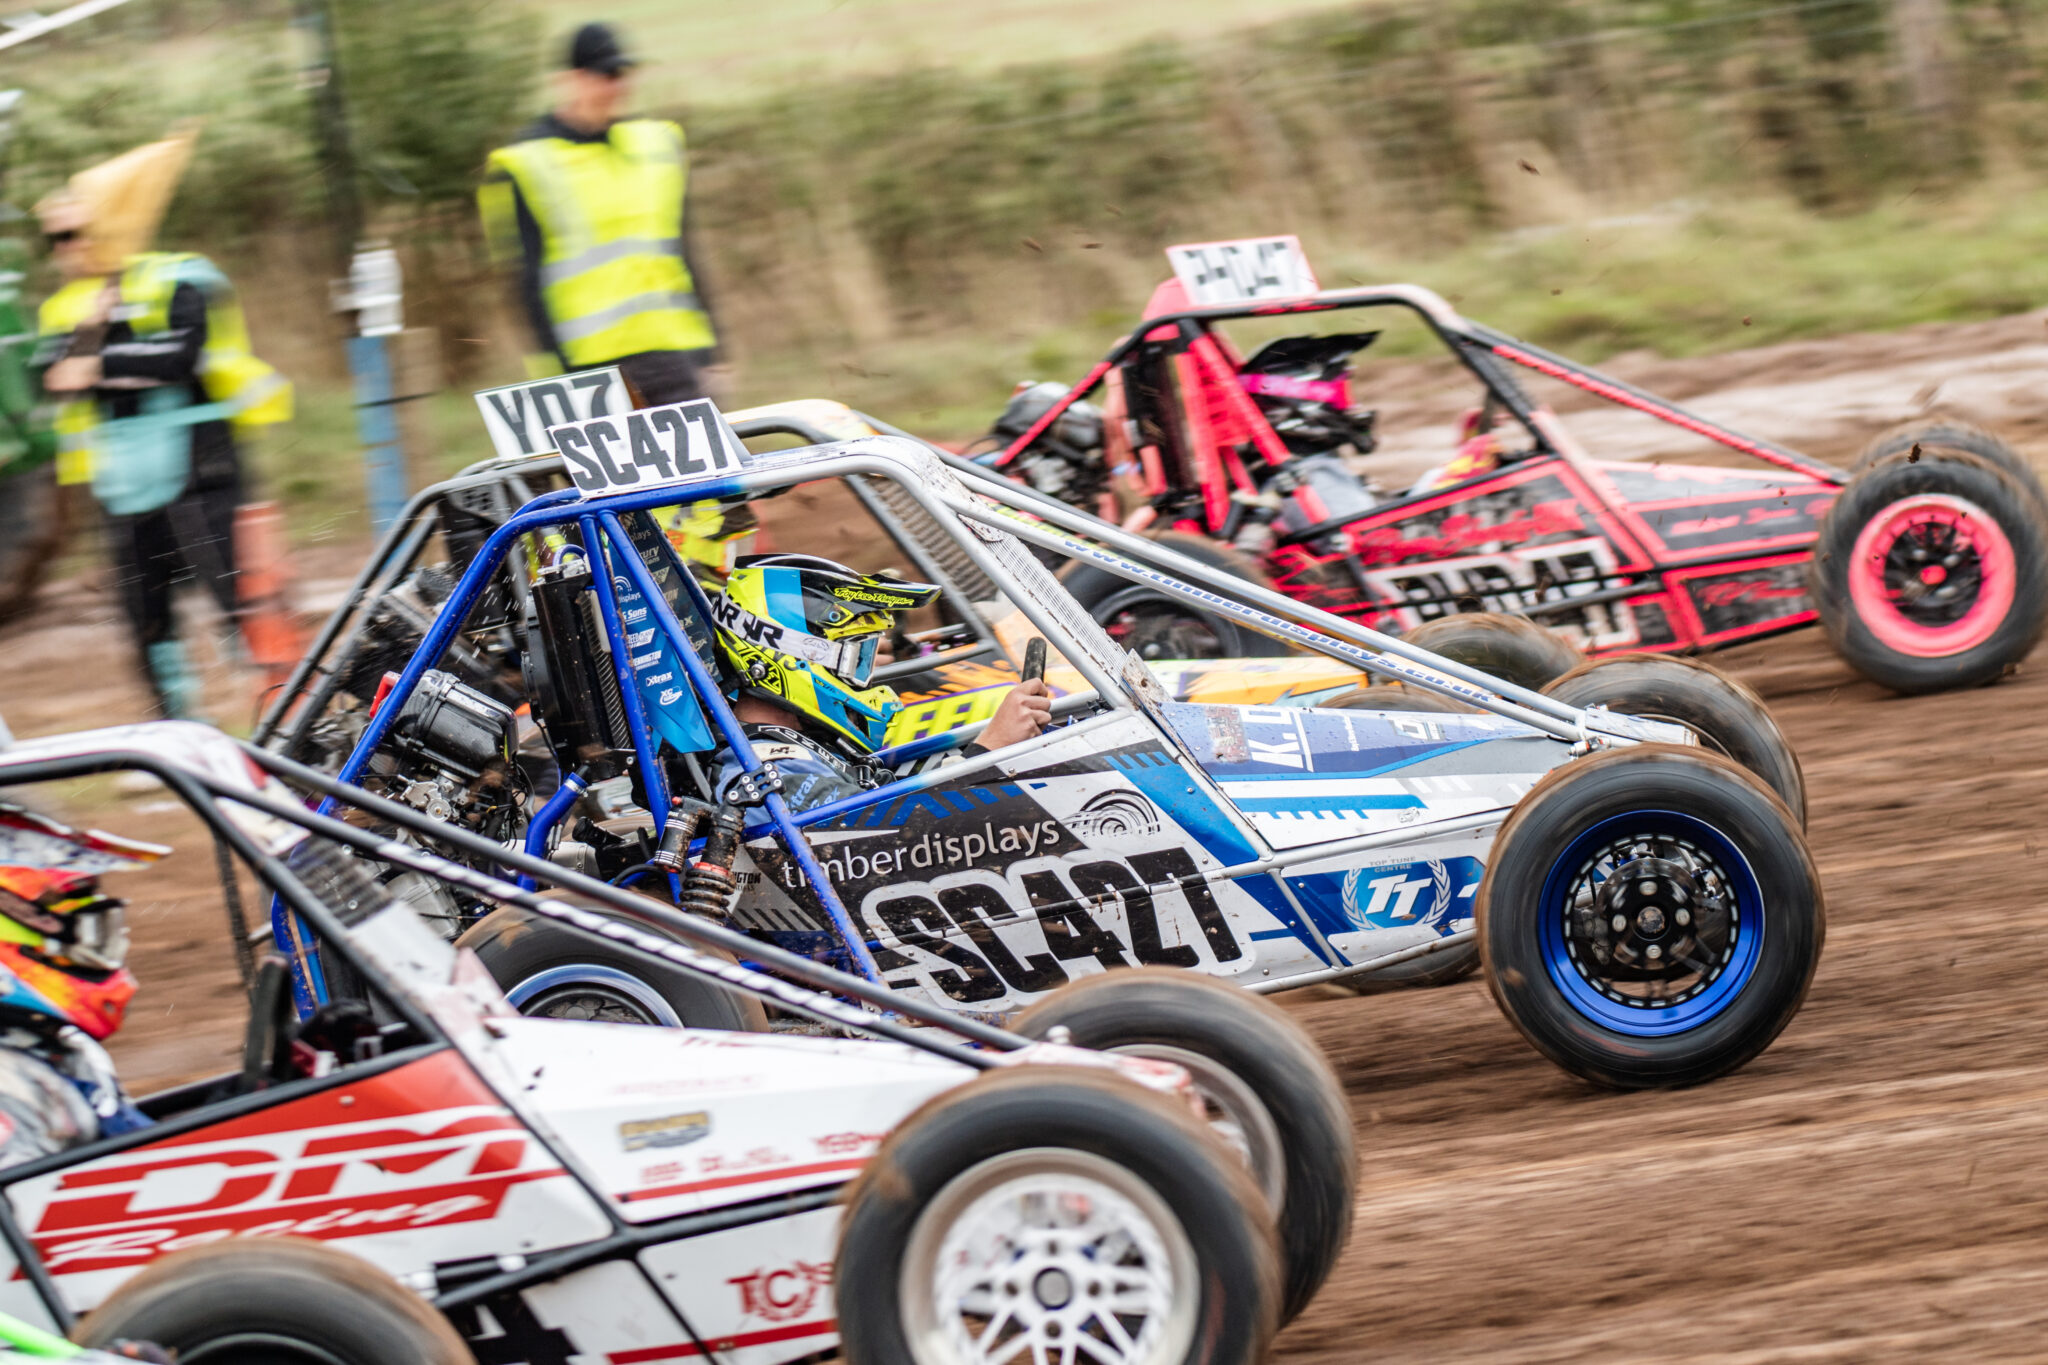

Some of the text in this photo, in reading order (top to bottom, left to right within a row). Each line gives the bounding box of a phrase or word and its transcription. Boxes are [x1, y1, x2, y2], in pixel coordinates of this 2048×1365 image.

[552, 402, 729, 491] SC427
[627, 607, 647, 618] Sons
[781, 819, 1061, 888] timberdisplays
[1374, 863, 1412, 873] CENTRE
[1390, 856, 1416, 864] TUNE
[867, 846, 1246, 1004] SC427
